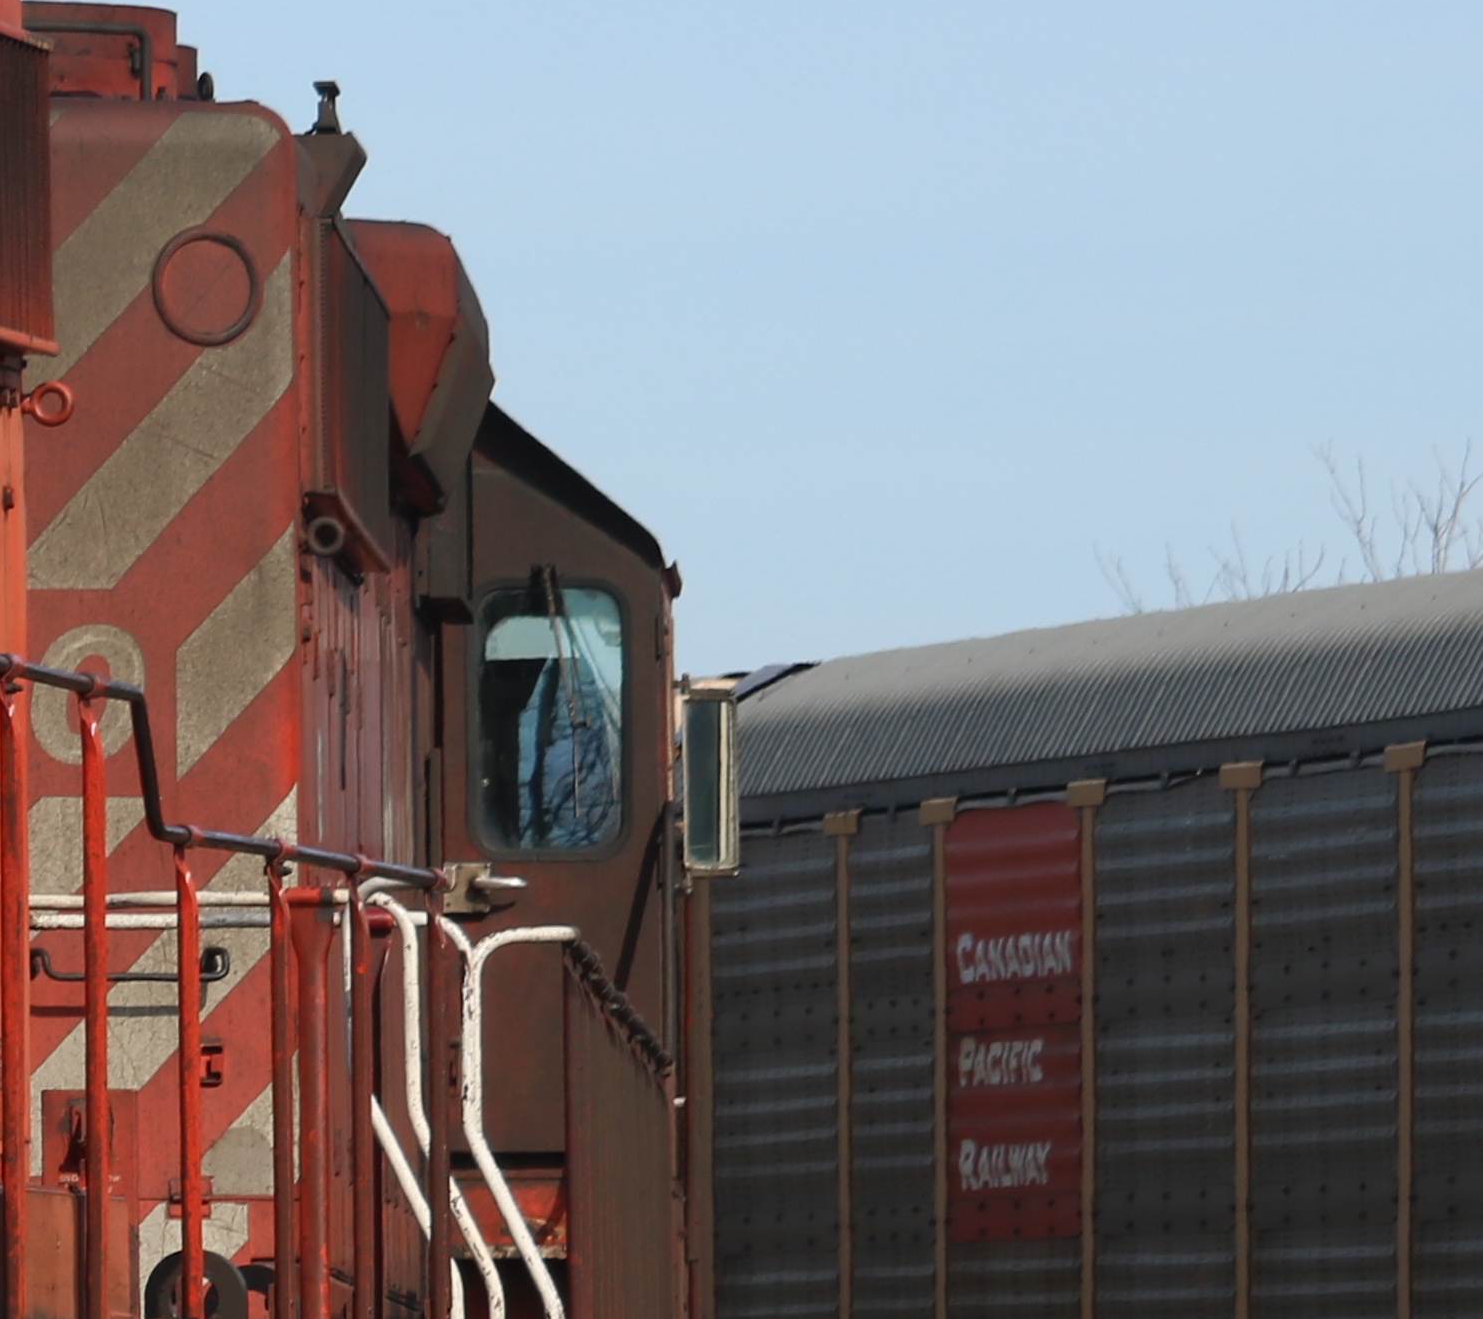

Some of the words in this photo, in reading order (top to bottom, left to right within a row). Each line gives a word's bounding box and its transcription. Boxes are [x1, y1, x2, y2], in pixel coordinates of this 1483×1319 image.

[956, 930, 1073, 983] CANADIAN
[959, 1036, 1044, 1087] PACIFIC
[959, 1139, 1051, 1191] RAILWAY
